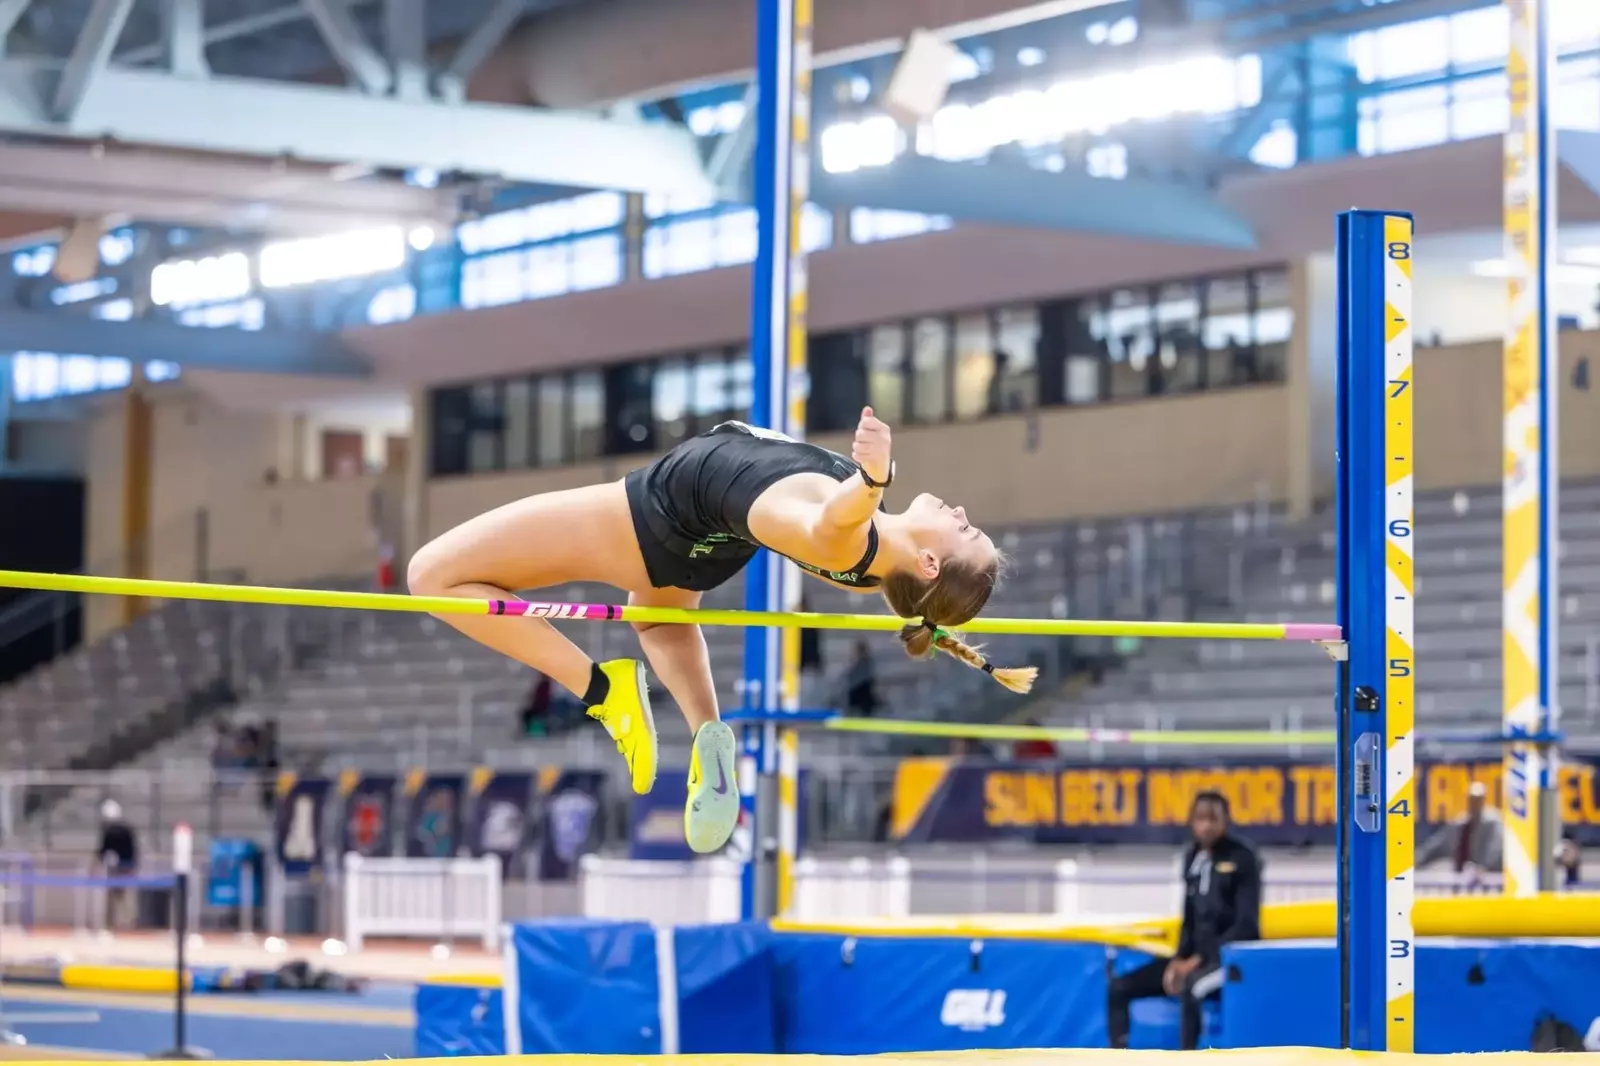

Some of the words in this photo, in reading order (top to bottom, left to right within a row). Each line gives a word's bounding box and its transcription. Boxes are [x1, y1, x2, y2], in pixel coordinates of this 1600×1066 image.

[1388, 242, 1410, 260] 8
[1388, 380, 1409, 398] 7
[1388, 519, 1410, 537] 6
[522, 602, 588, 619] GILL
[1389, 659, 1410, 677] 5
[984, 769, 1057, 826] SUN
[1060, 768, 1144, 826] BELT
[1388, 799, 1411, 817] 4
[1389, 940, 1410, 958] 3
